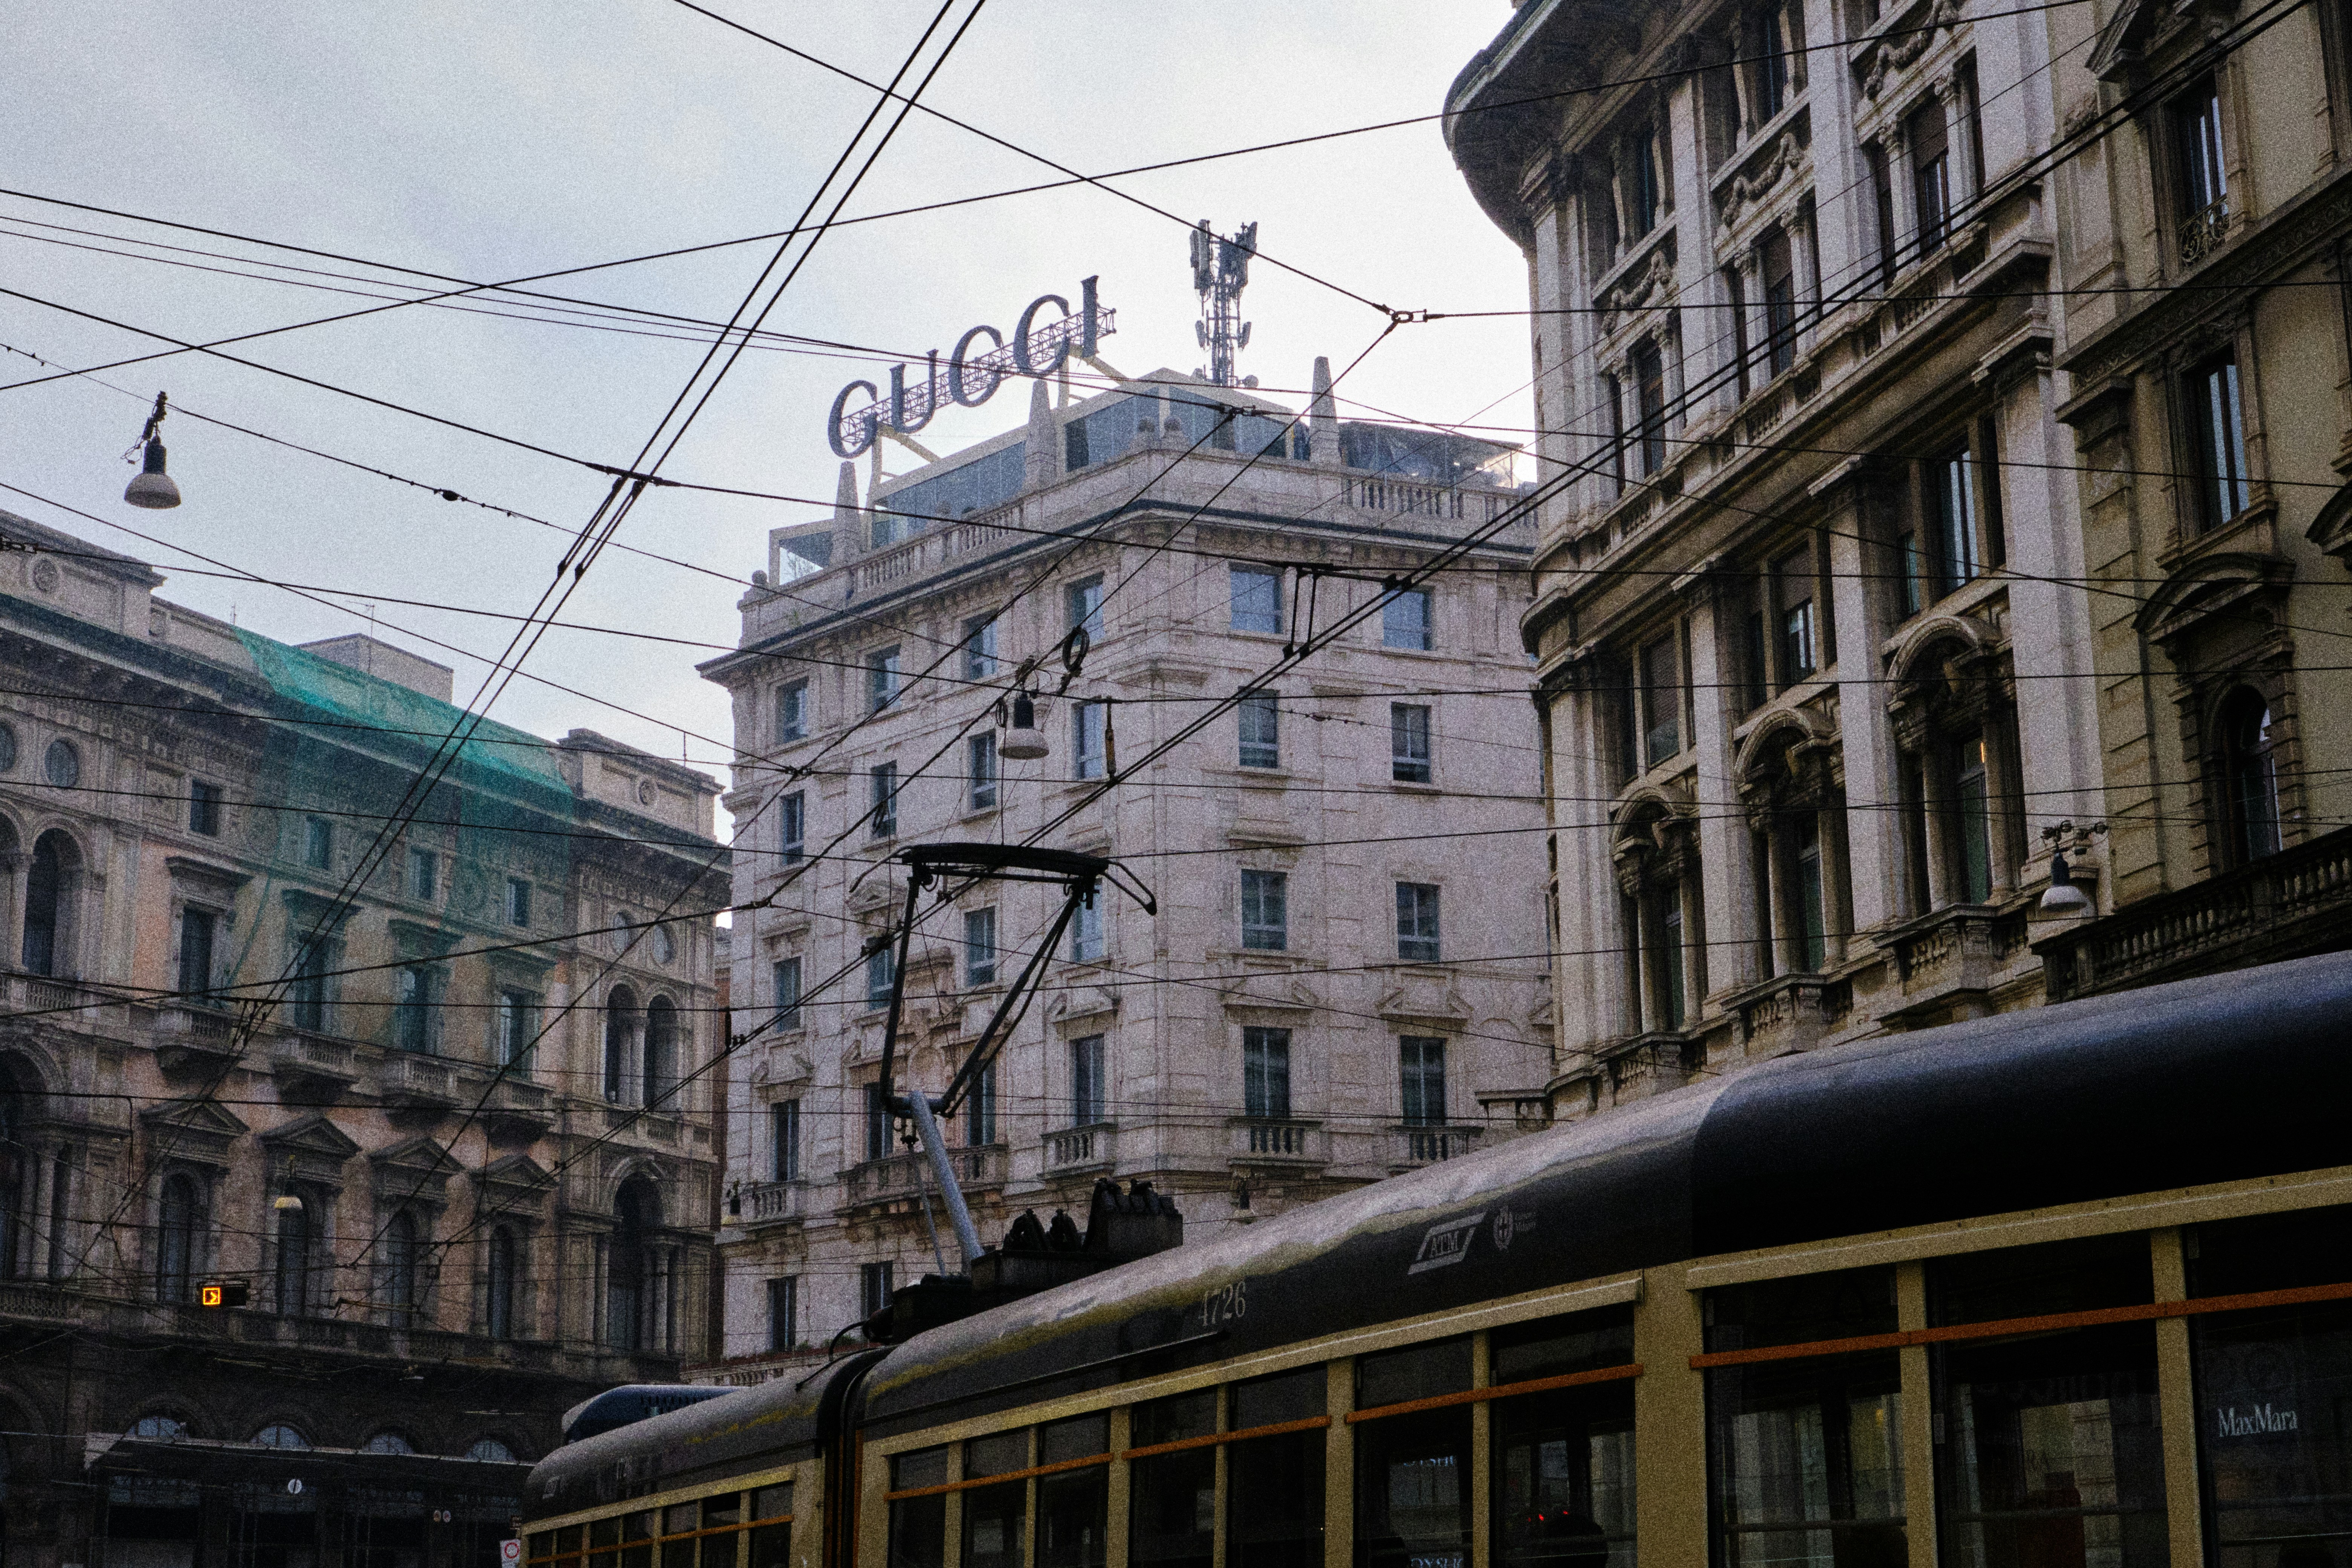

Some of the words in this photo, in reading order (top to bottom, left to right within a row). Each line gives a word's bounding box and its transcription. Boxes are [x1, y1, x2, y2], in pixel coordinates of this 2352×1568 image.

[828, 275, 1099, 458] GUCCI
[1430, 1231, 1459, 1257] ATM
[1197, 1281, 1246, 1326] 4726
[2217, 1403, 2298, 1437] MaxMara
